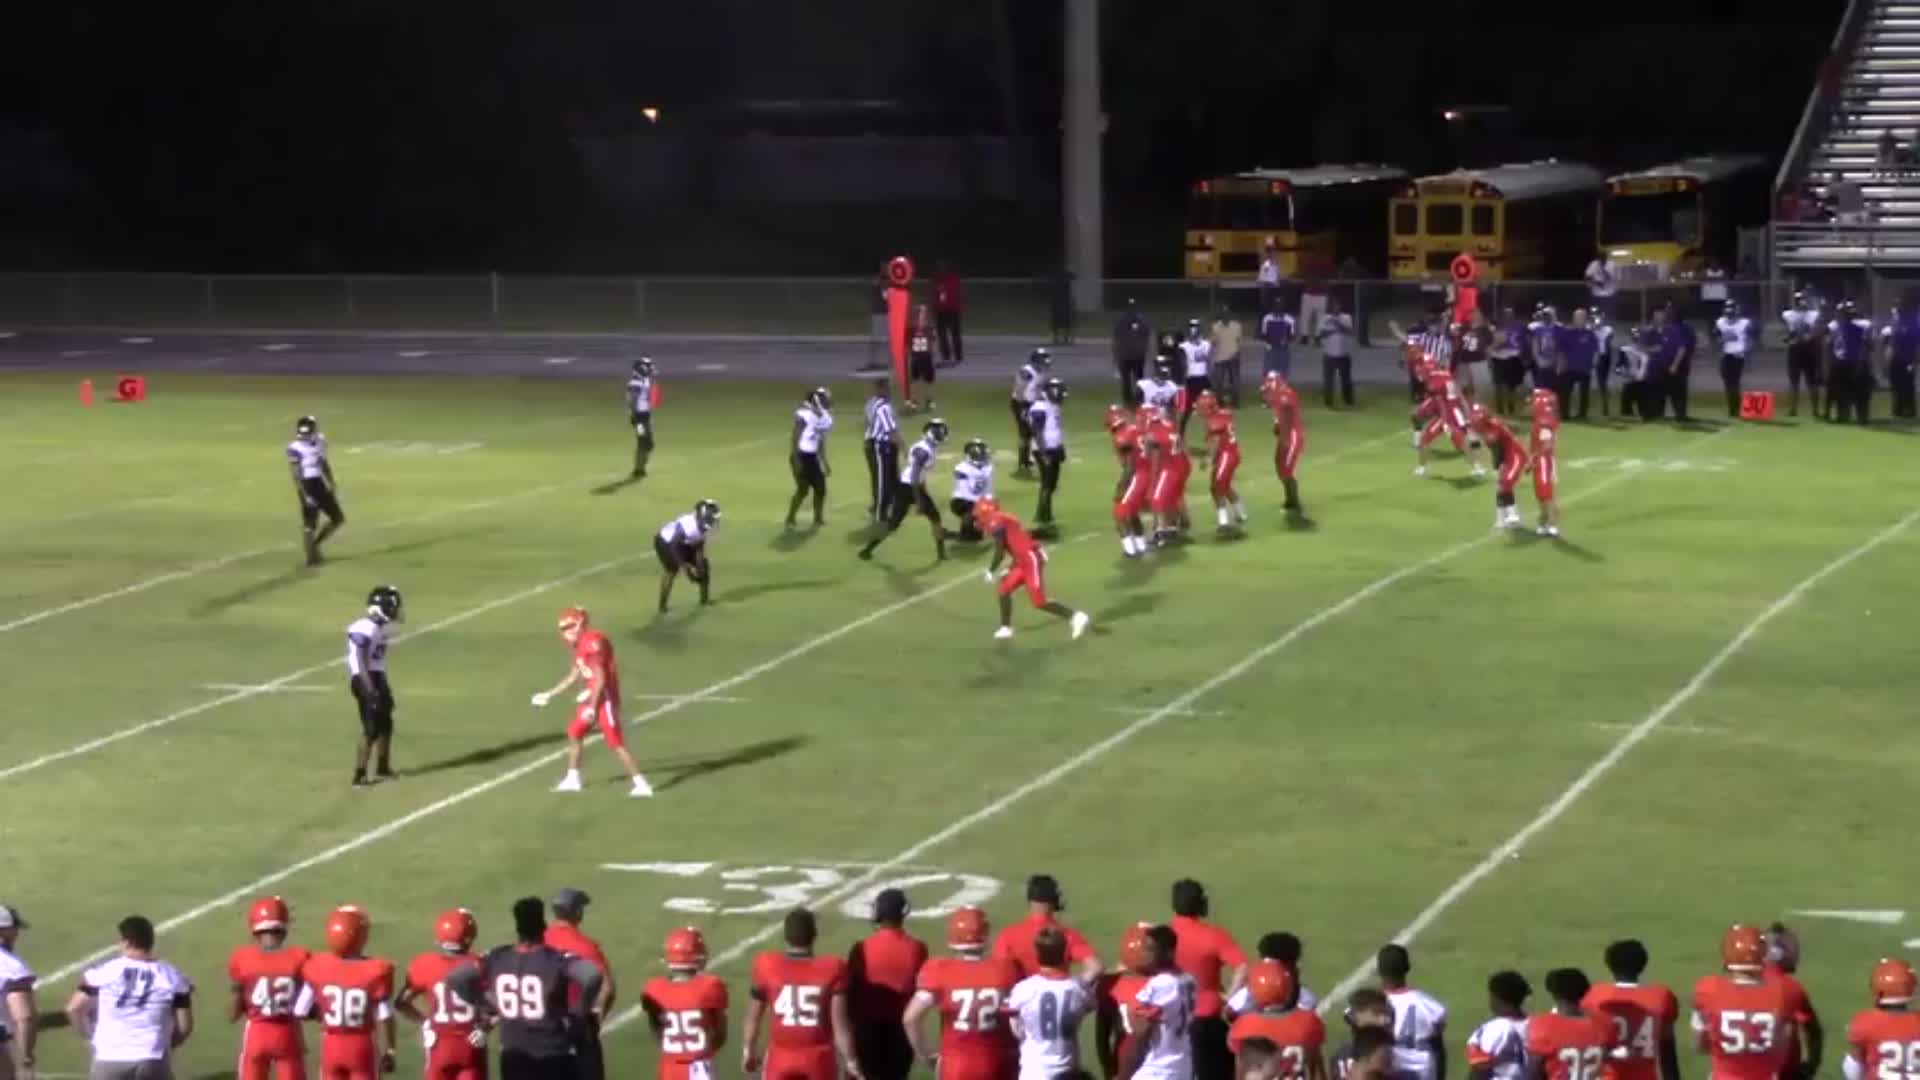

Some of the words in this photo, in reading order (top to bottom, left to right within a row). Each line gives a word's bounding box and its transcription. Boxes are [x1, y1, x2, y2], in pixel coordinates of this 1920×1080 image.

[251, 975, 295, 1016] 42
[321, 984, 368, 1027] 38
[496, 973, 545, 1020] 69
[773, 984, 822, 1027] 45
[951, 987, 999, 1032] 72
[661, 1009, 707, 1054] 25
[1719, 1009, 1776, 1054] 53
